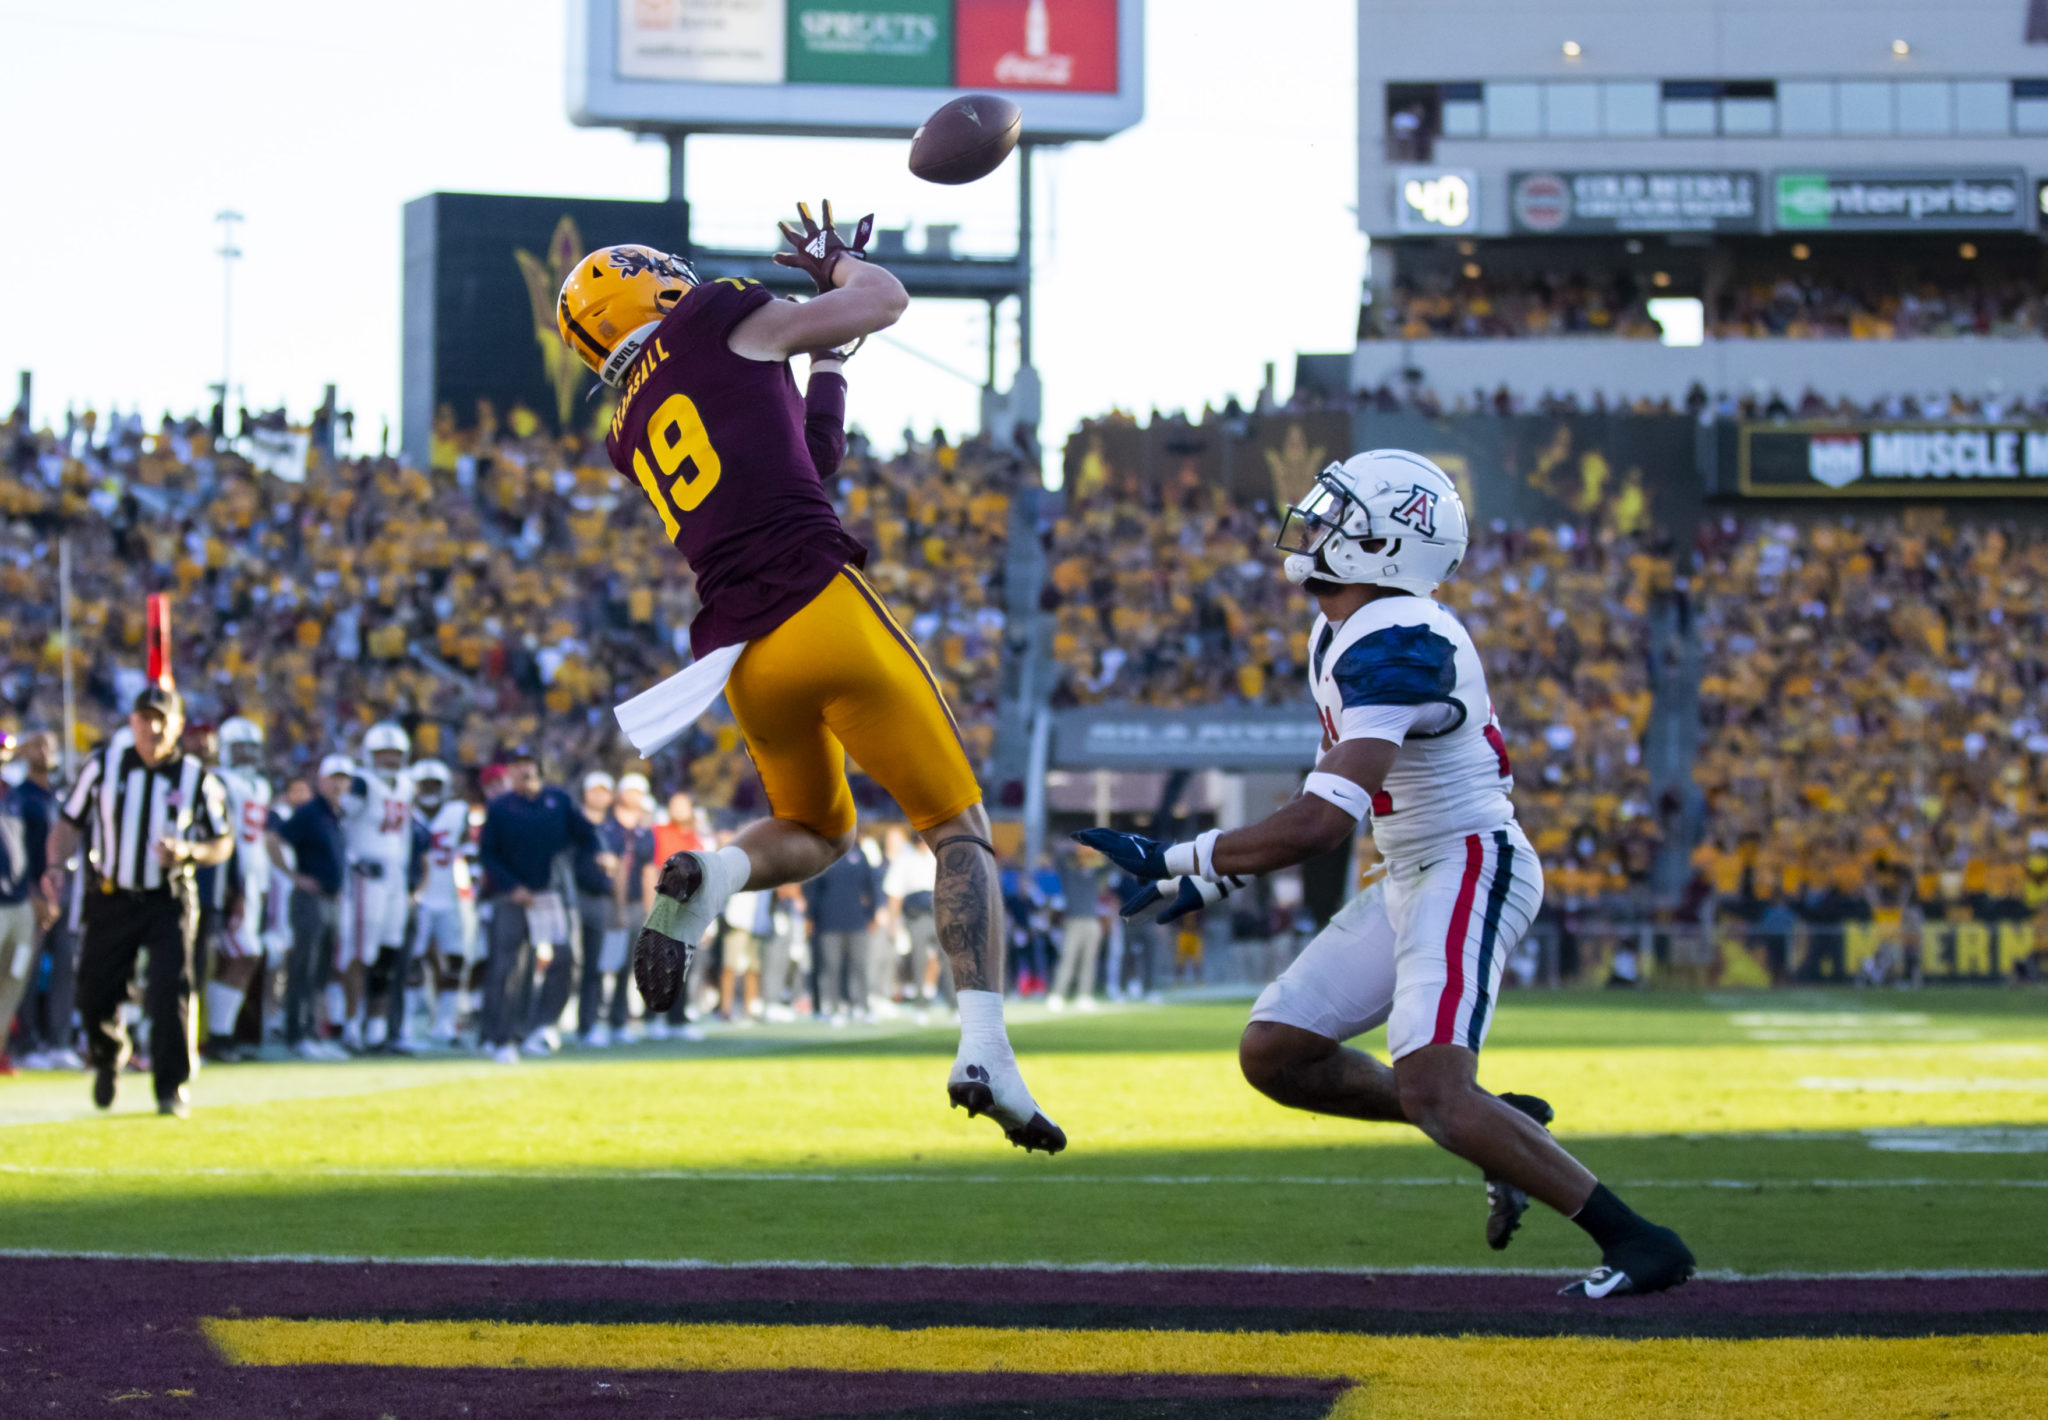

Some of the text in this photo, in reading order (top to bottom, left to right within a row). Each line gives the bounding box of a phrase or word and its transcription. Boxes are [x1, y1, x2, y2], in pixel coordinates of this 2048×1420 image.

[1405, 174, 1469, 226] 40
[610, 340, 640, 373] DEVILS
[632, 393, 721, 543] 19
[1869, 430, 2020, 478] MUSCLE
[1390, 484, 1438, 538] A
